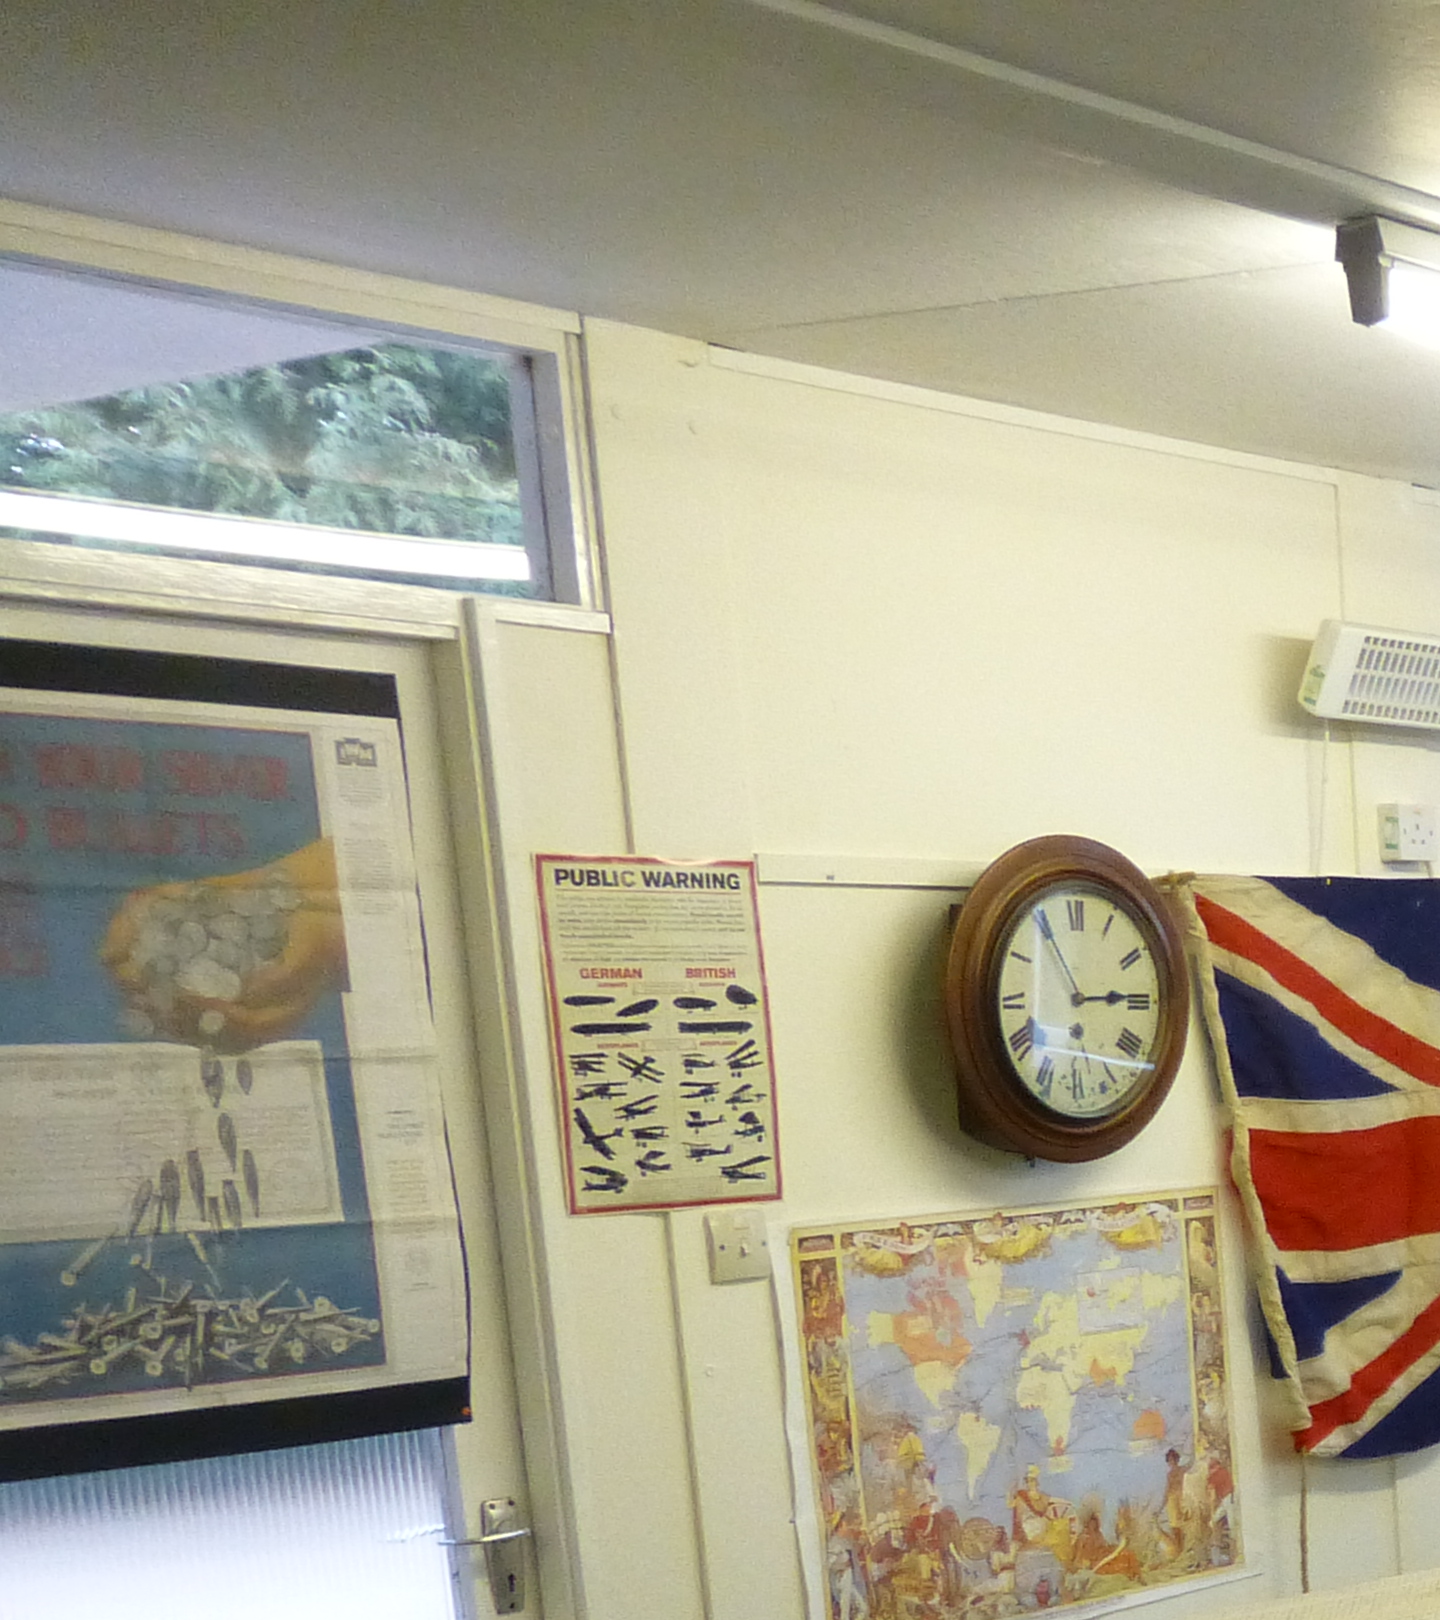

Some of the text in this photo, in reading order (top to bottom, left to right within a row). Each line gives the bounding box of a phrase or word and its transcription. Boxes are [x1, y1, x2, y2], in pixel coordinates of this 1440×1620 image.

[554, 868, 741, 890] PUBLIC WARNING
[580, 968, 736, 979] GERMAN BRITISH
